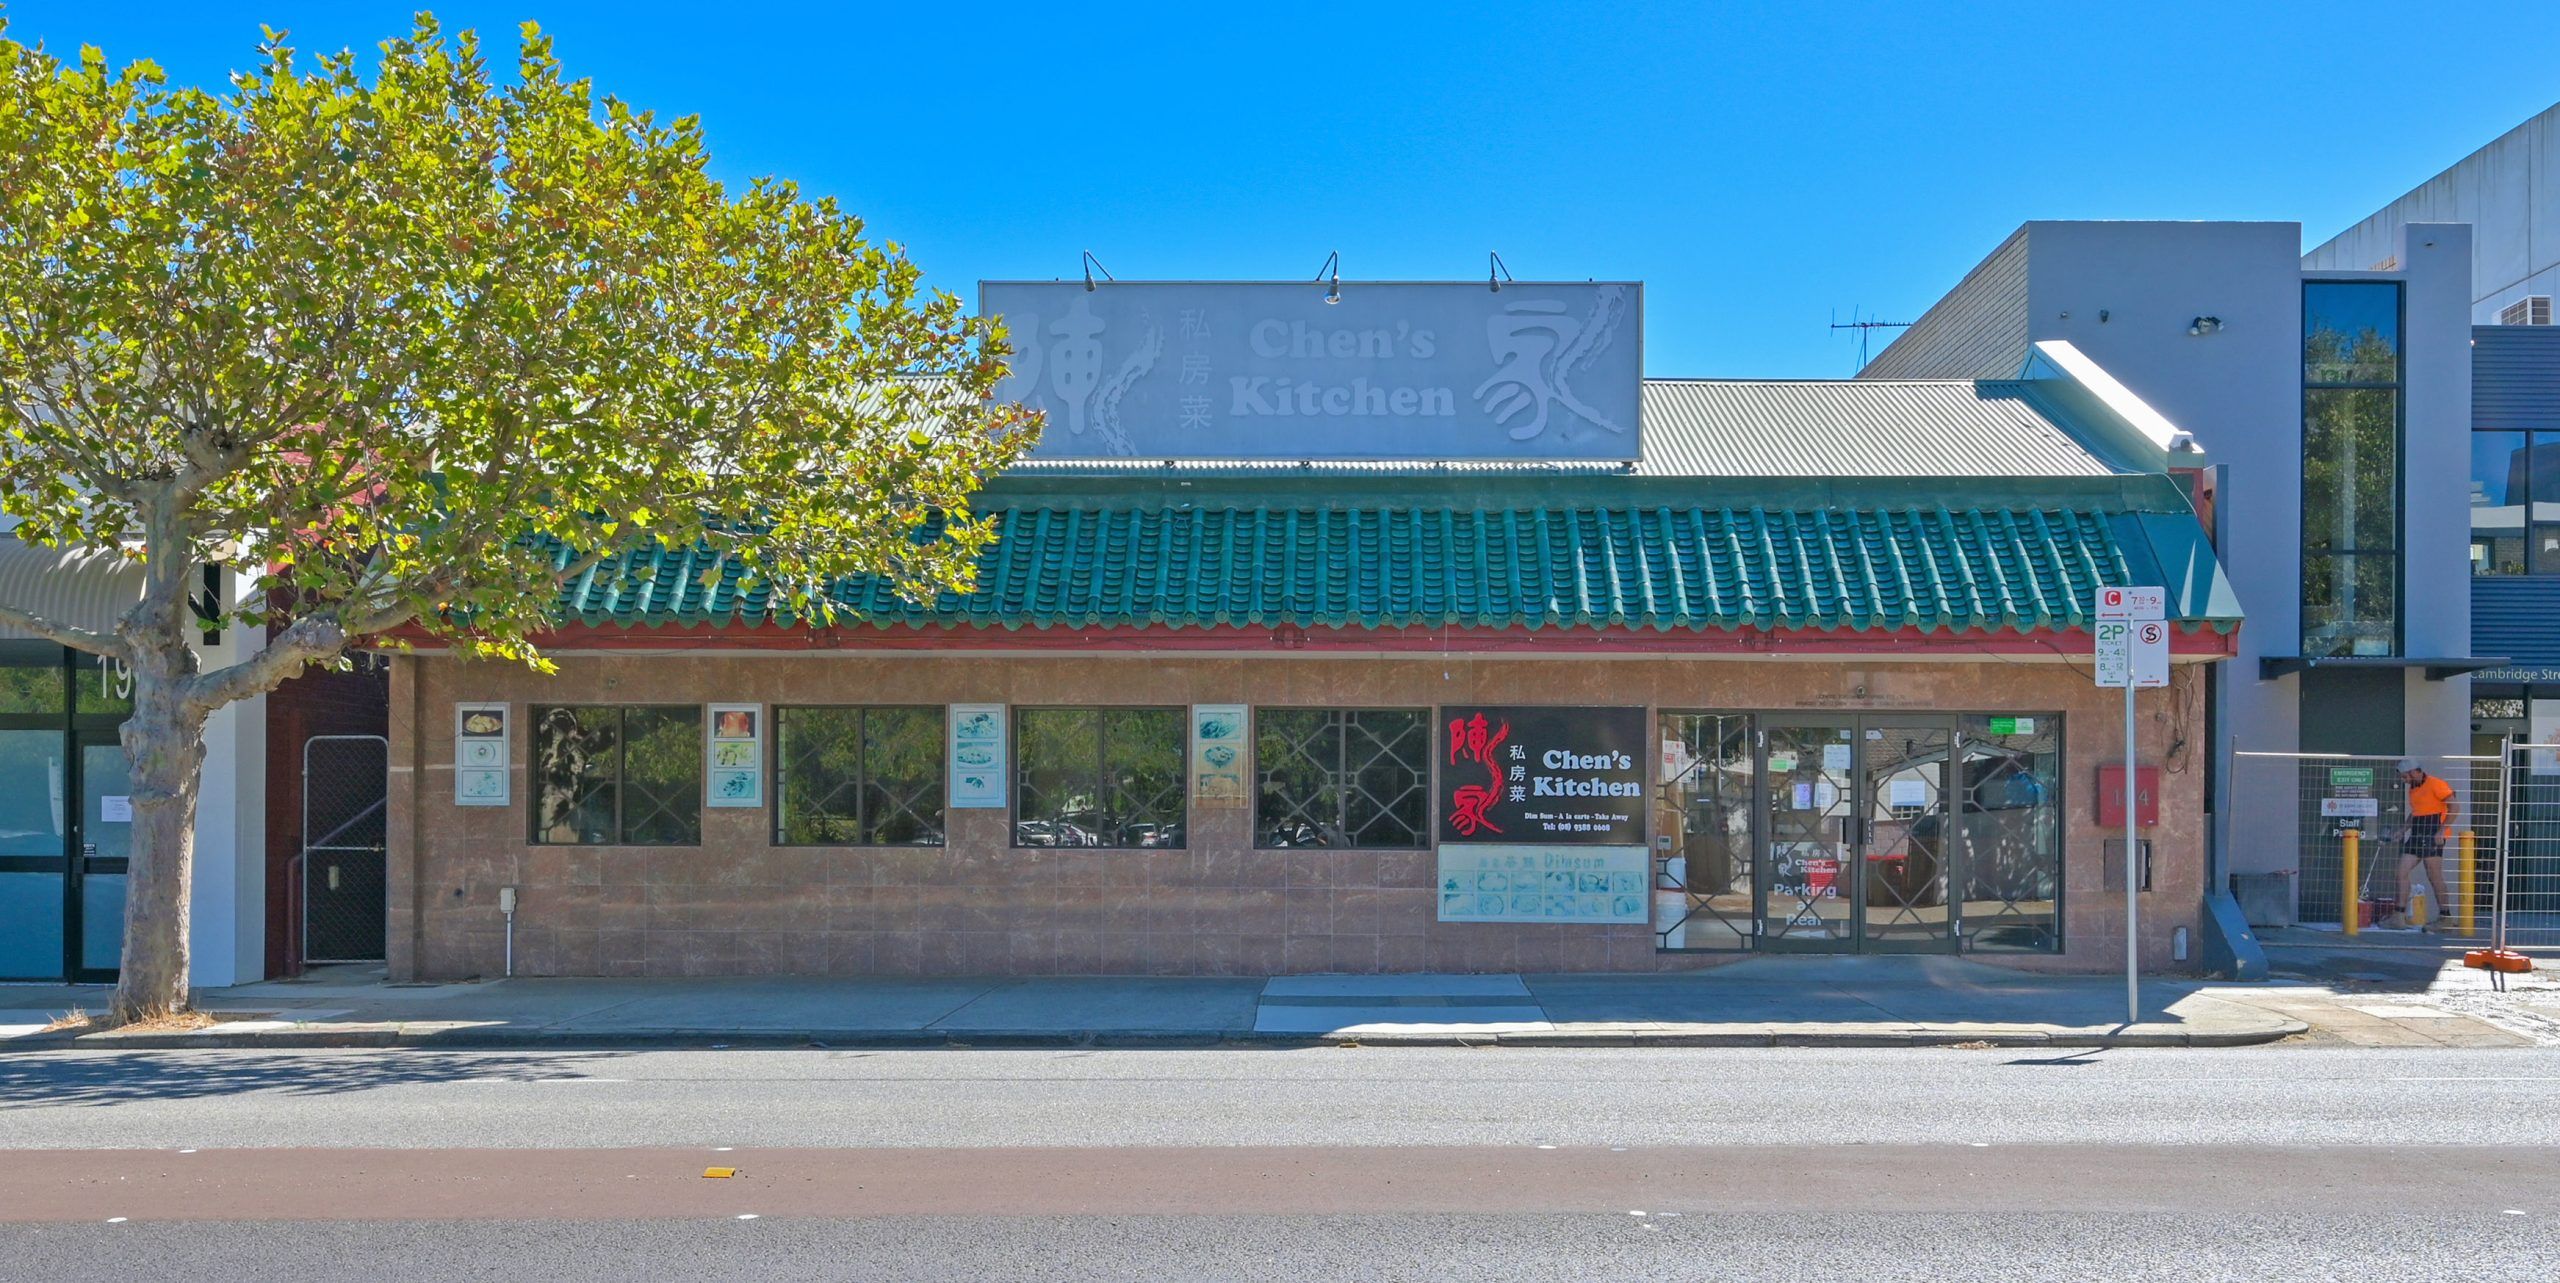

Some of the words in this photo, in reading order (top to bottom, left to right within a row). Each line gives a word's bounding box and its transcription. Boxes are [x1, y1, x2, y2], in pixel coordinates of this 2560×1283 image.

[1249, 319, 1435, 360] Chen's
[1179, 308, 1213, 430] 私房菜
[1227, 376, 1457, 418] Kitchen
[2099, 625, 2125, 640] 2P
[1542, 750, 1632, 770] Chen's
[1509, 744, 1526, 803] 私房菜
[1533, 776, 1641, 797] Kitchen
[1611, 813, 1629, 822] Away
[2339, 819, 2360, 828] Staff
[1774, 883, 1837, 899] Parking
